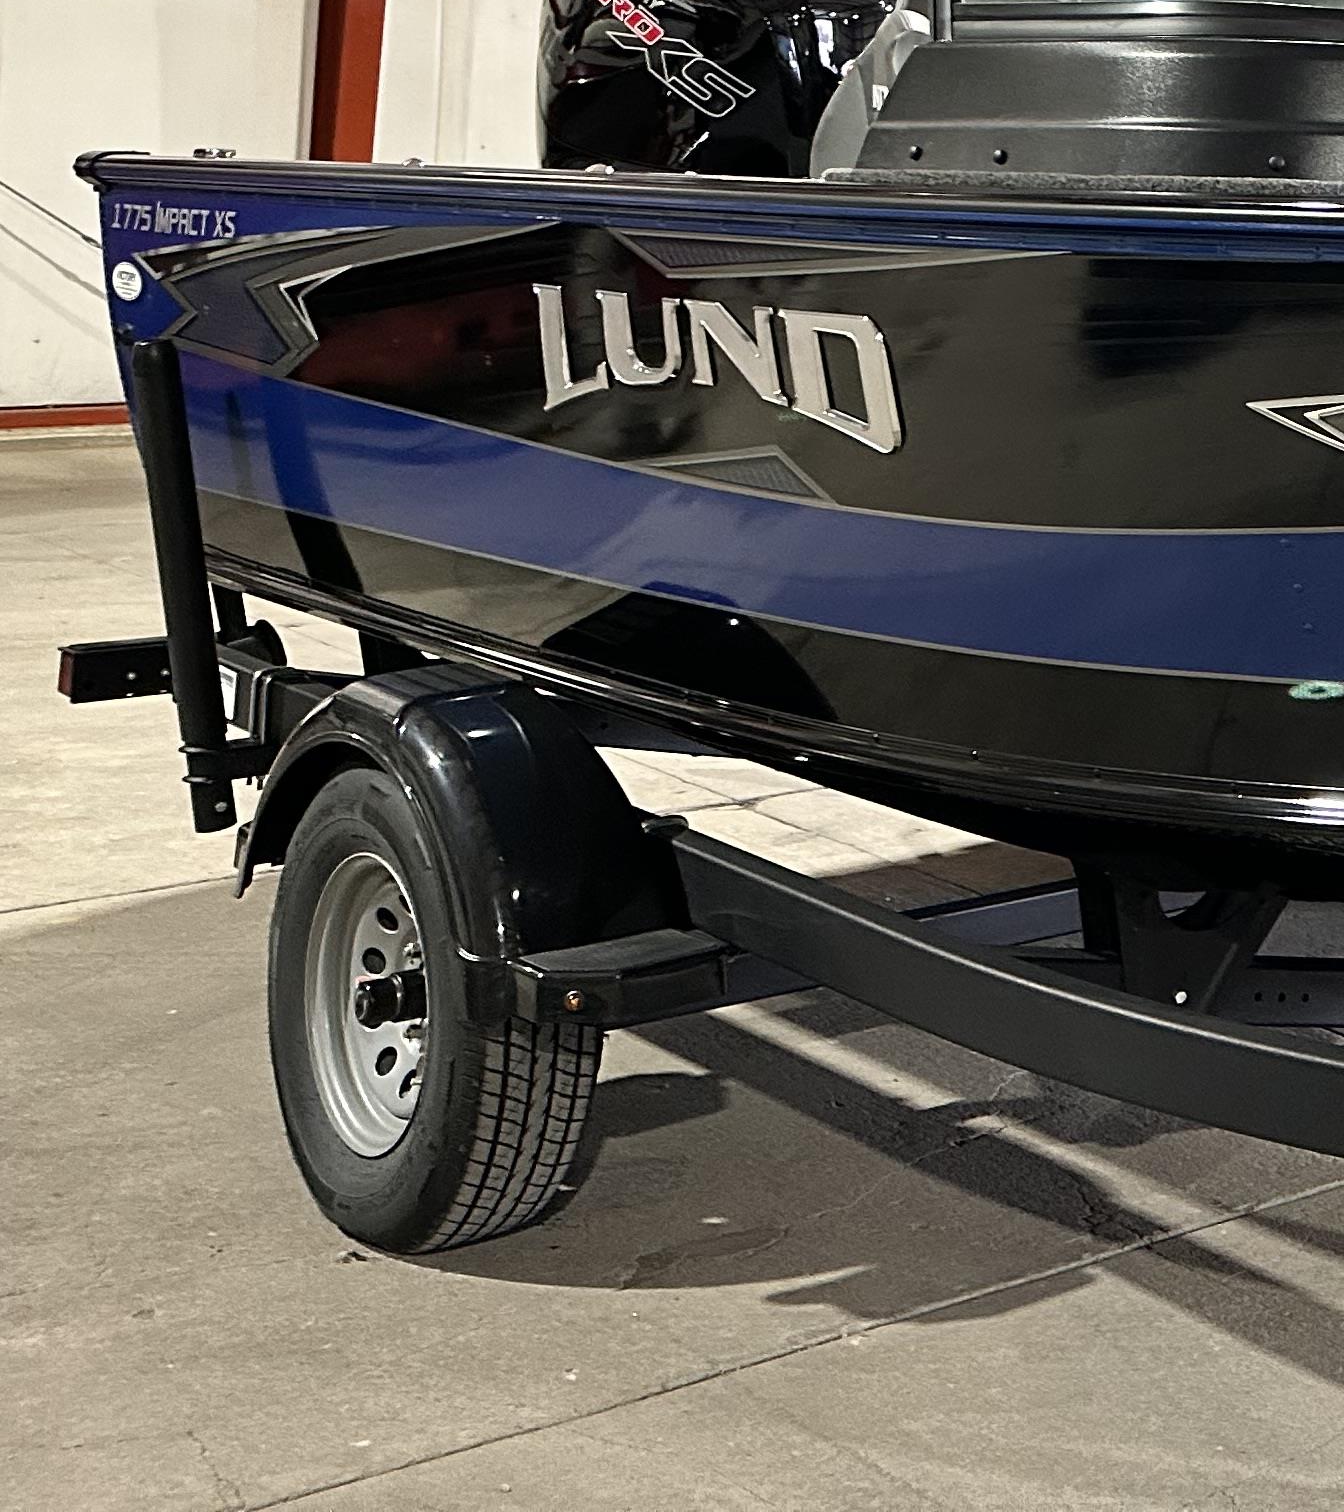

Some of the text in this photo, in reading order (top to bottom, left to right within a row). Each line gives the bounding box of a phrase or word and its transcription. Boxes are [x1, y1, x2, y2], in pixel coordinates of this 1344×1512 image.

[605, 31, 756, 118] XS
[110, 201, 237, 238] 1775 IMPACT XS
[532, 282, 905, 454] LUND
